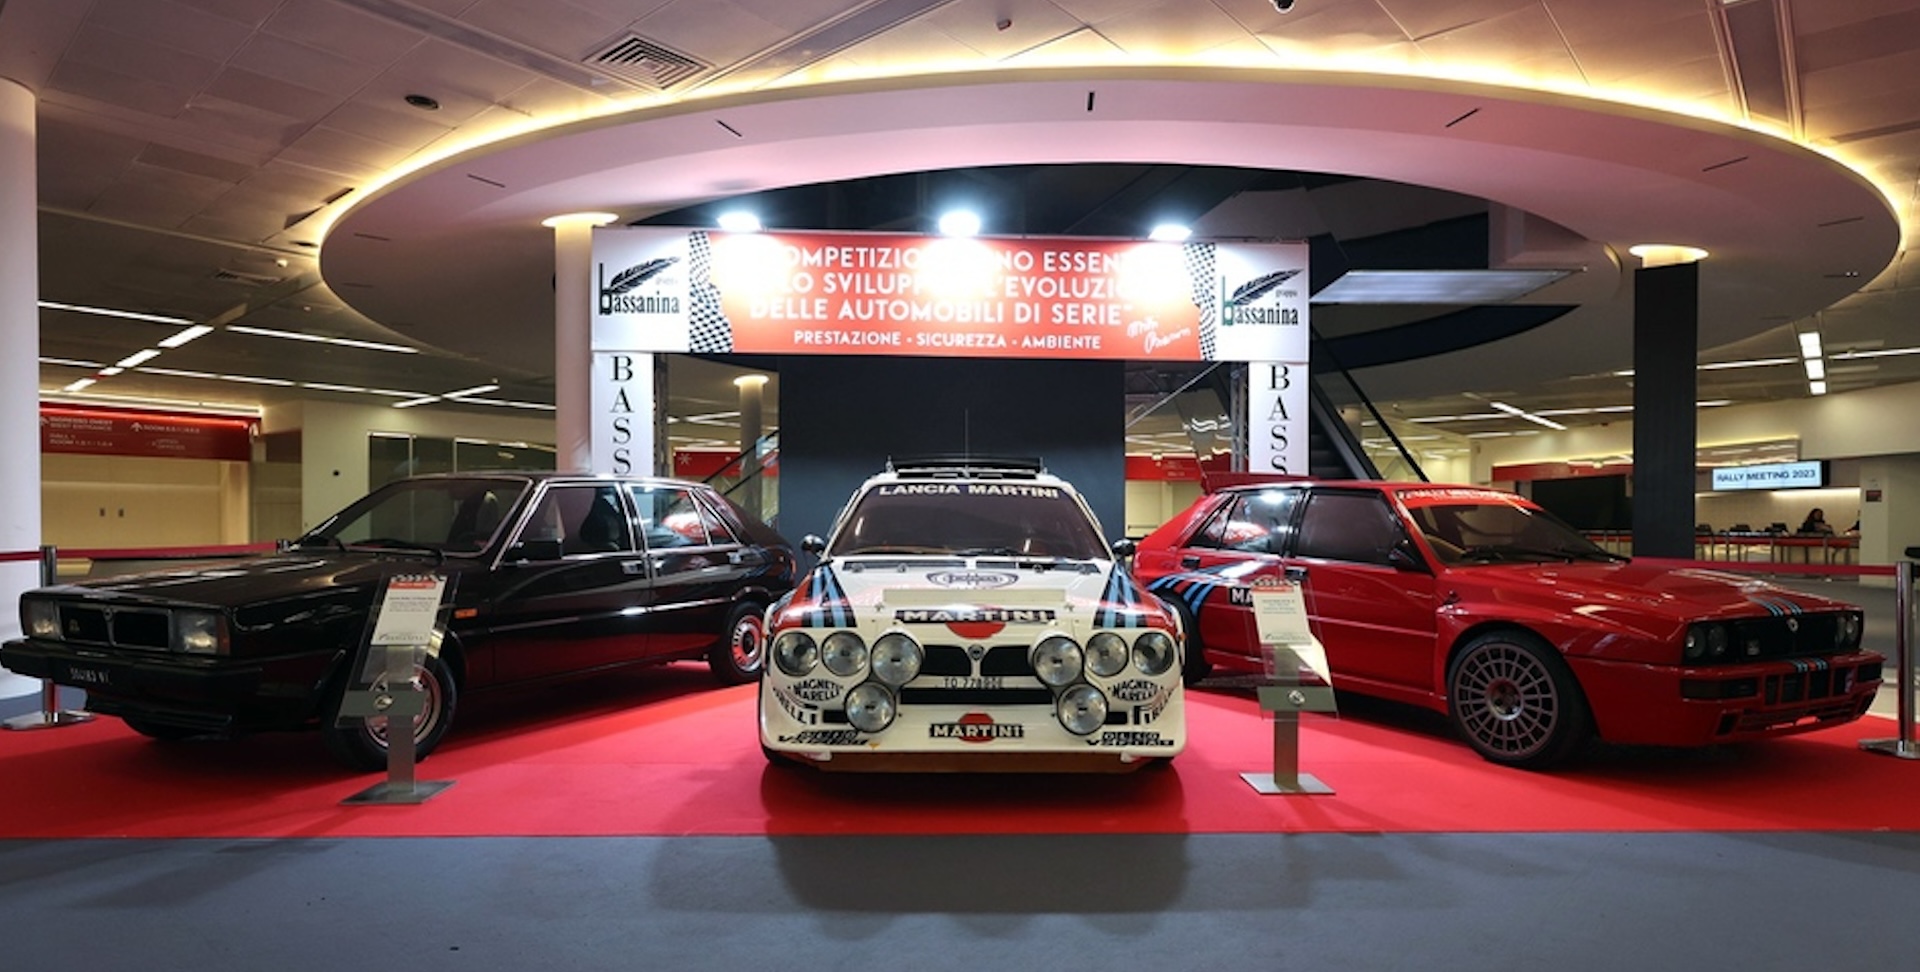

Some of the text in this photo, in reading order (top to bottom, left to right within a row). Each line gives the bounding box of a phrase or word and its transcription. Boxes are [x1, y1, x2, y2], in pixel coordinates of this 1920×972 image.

[995, 250, 1034, 272] NO
[1044, 250, 1119, 273] ESSEN
[599, 262, 680, 315] bassanina
[1221, 275, 1299, 326] bassanina
[750, 298, 828, 320] DELLE
[837, 298, 1004, 323] AUTOMOBILI
[1014, 302, 1041, 324] DI
[793, 330, 1102, 349] PRESTAZIONE SICUREZZA AMBIENTE
[1716, 469, 1816, 482] RALLY MEETING 2023
[879, 484, 1059, 498] LANCIA MARTINI
[1231, 588, 1253, 604] MA
[904, 610, 1049, 622] MARTINI
[933, 724, 1020, 737] MARTINI
